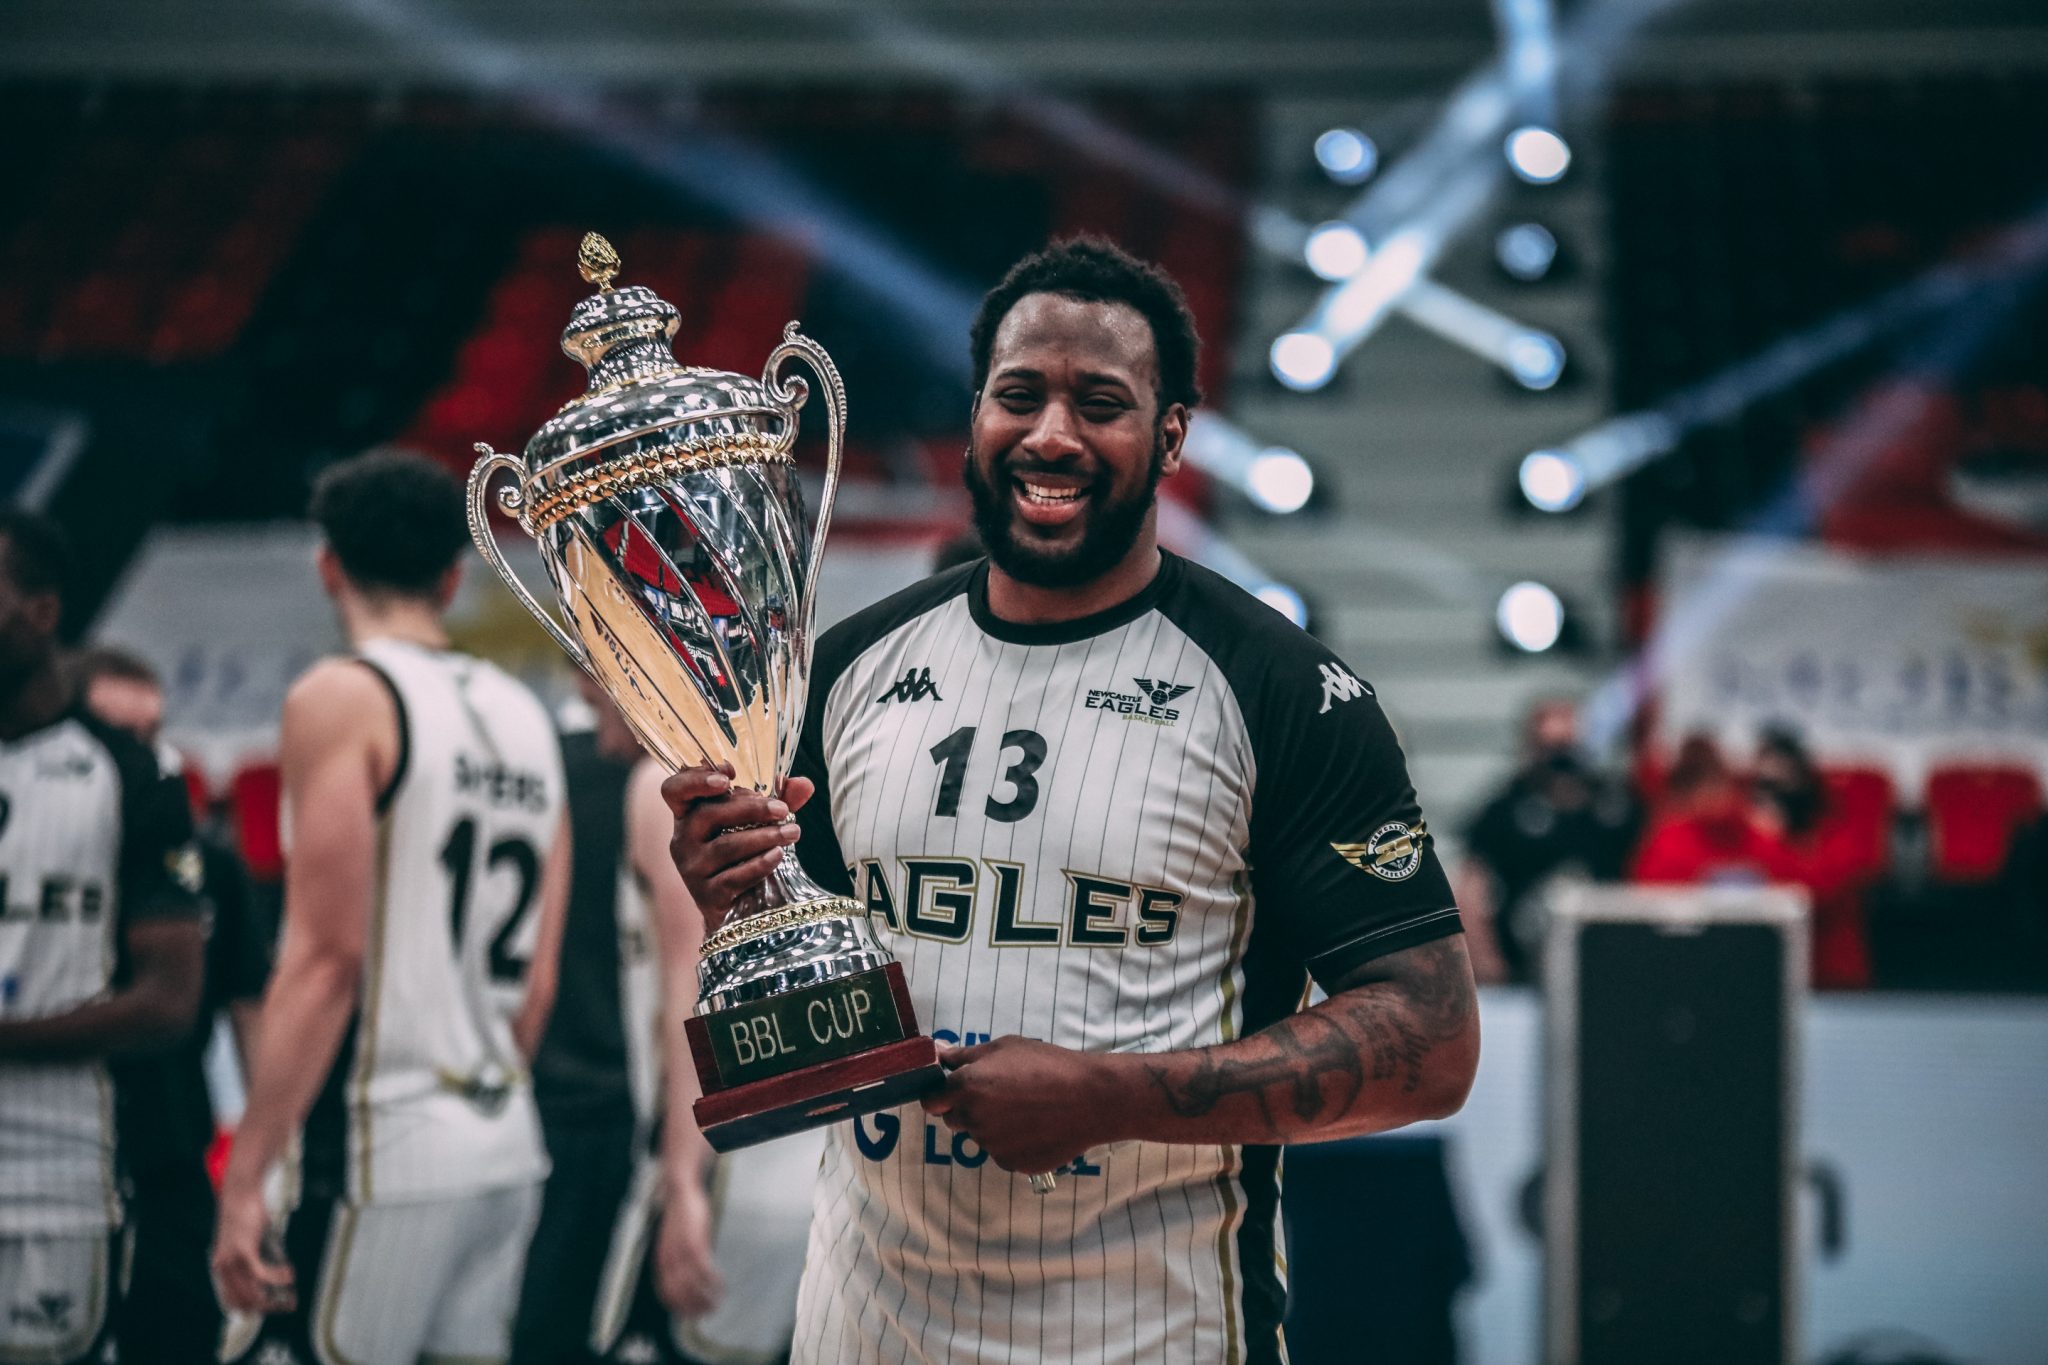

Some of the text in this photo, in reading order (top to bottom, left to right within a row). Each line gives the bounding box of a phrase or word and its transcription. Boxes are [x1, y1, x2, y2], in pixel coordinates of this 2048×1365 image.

[1085, 695, 1180, 721] EAGLES
[1088, 688, 1143, 703] NEWCASTLE
[1121, 713, 1176, 728] BASKETBALL
[929, 726, 1048, 823] 13
[437, 813, 542, 984] 12
[848, 856, 1187, 949] AGLES
[729, 988, 872, 1066] BBL CUP
